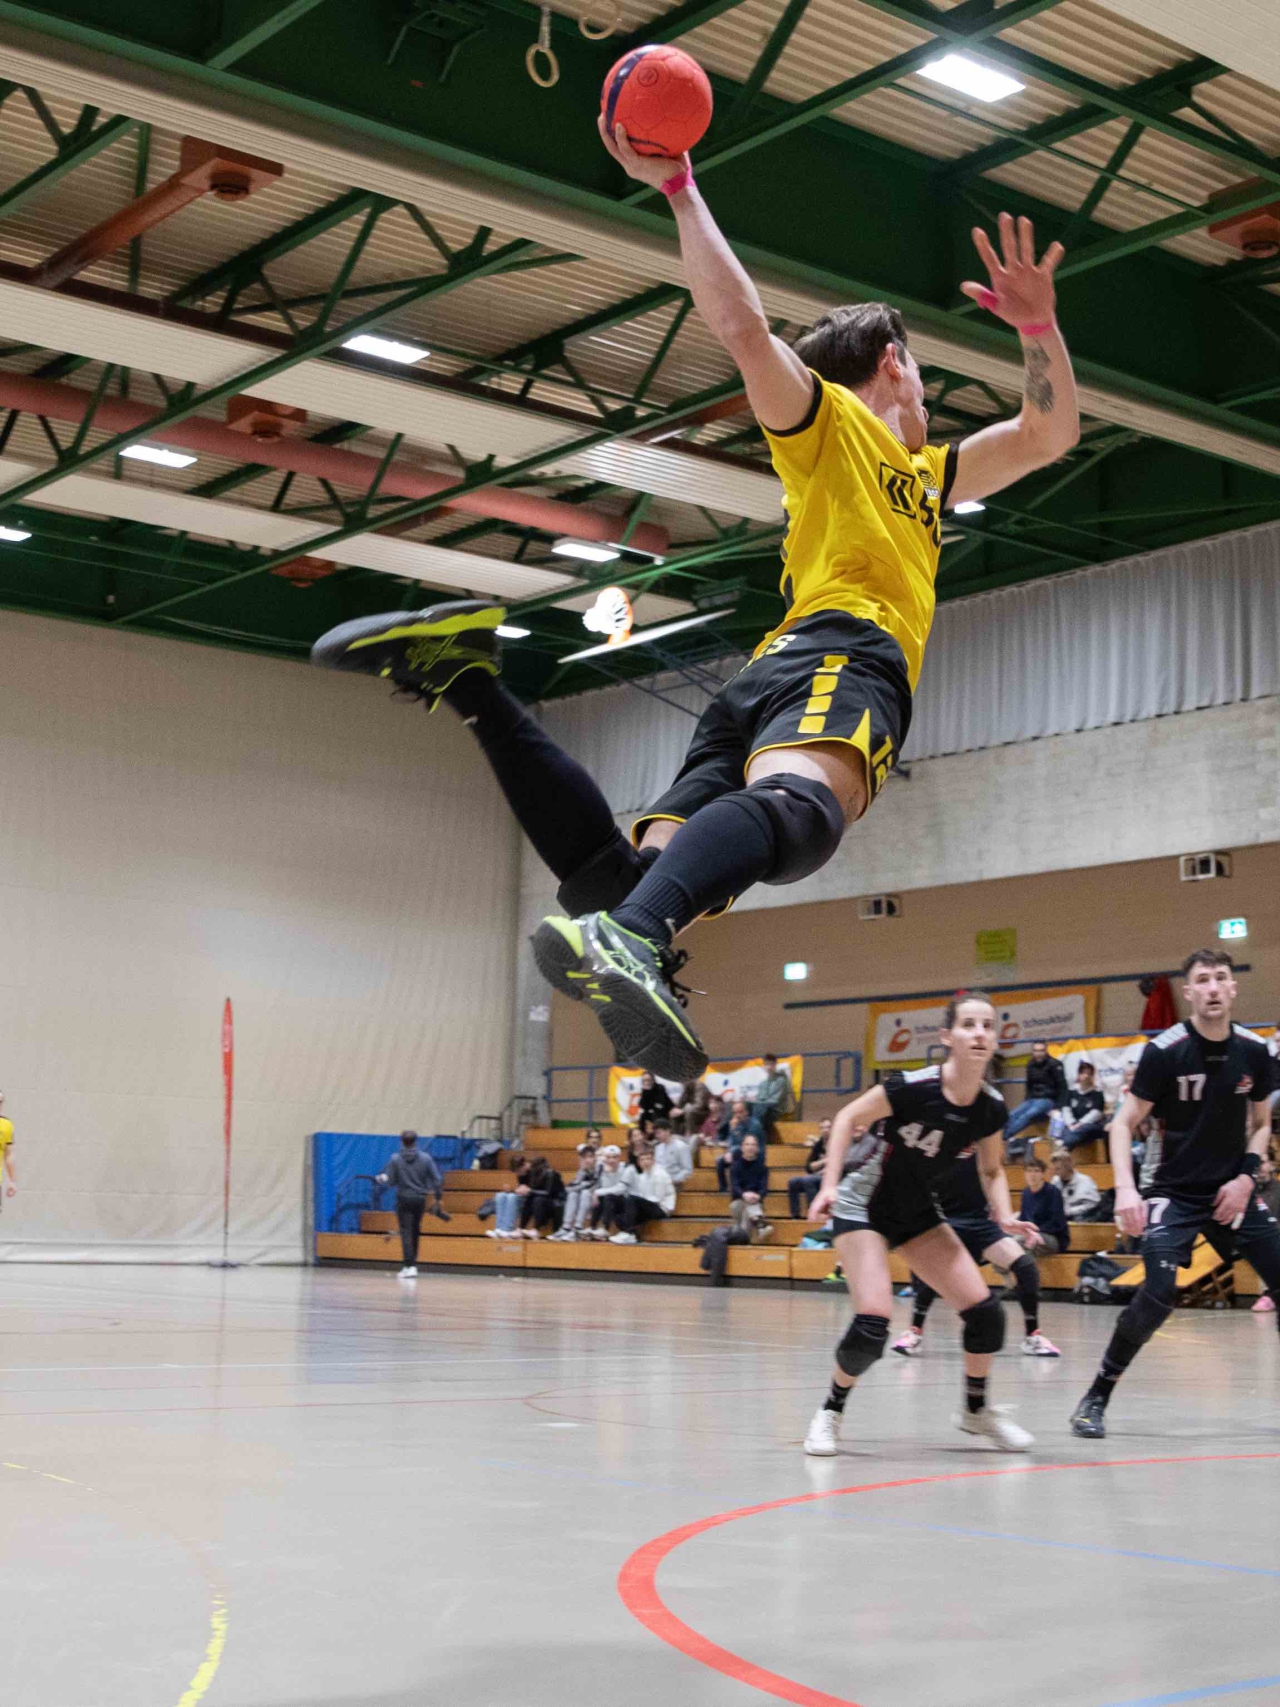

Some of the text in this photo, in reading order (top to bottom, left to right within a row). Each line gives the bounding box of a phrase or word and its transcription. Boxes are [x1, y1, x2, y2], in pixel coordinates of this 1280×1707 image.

[1176, 1073, 1207, 1102] 17
[897, 1122, 945, 1158] 44
[1146, 1197, 1170, 1224] 7
